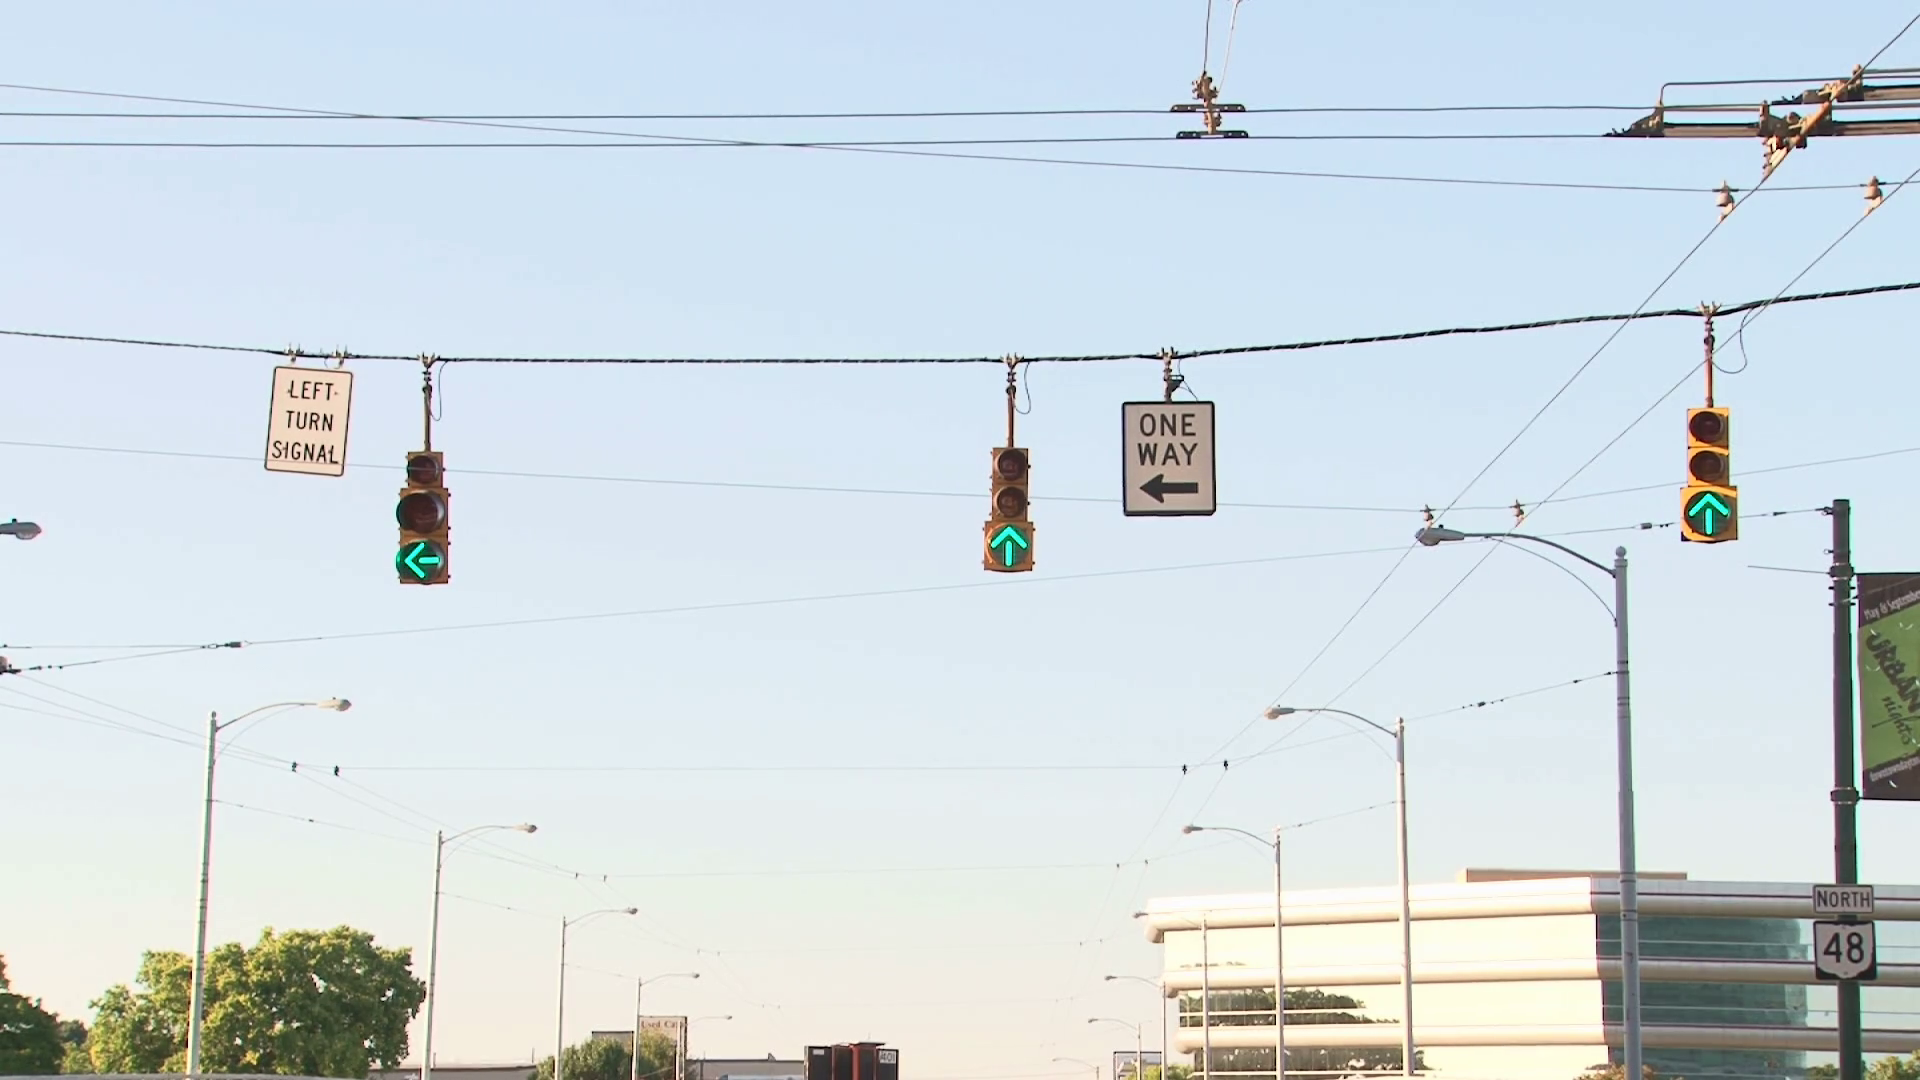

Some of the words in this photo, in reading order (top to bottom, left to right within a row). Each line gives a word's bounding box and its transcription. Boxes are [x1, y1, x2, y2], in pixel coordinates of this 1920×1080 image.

[290, 380, 334, 401] LEFT
[286, 410, 334, 432] TURN
[1139, 413, 1196, 437] ONE
[271, 440, 339, 464] SIGNAL
[1137, 442, 1198, 466] WAY
[1816, 889, 1870, 908] NORTH
[1823, 932, 1864, 964] 48
